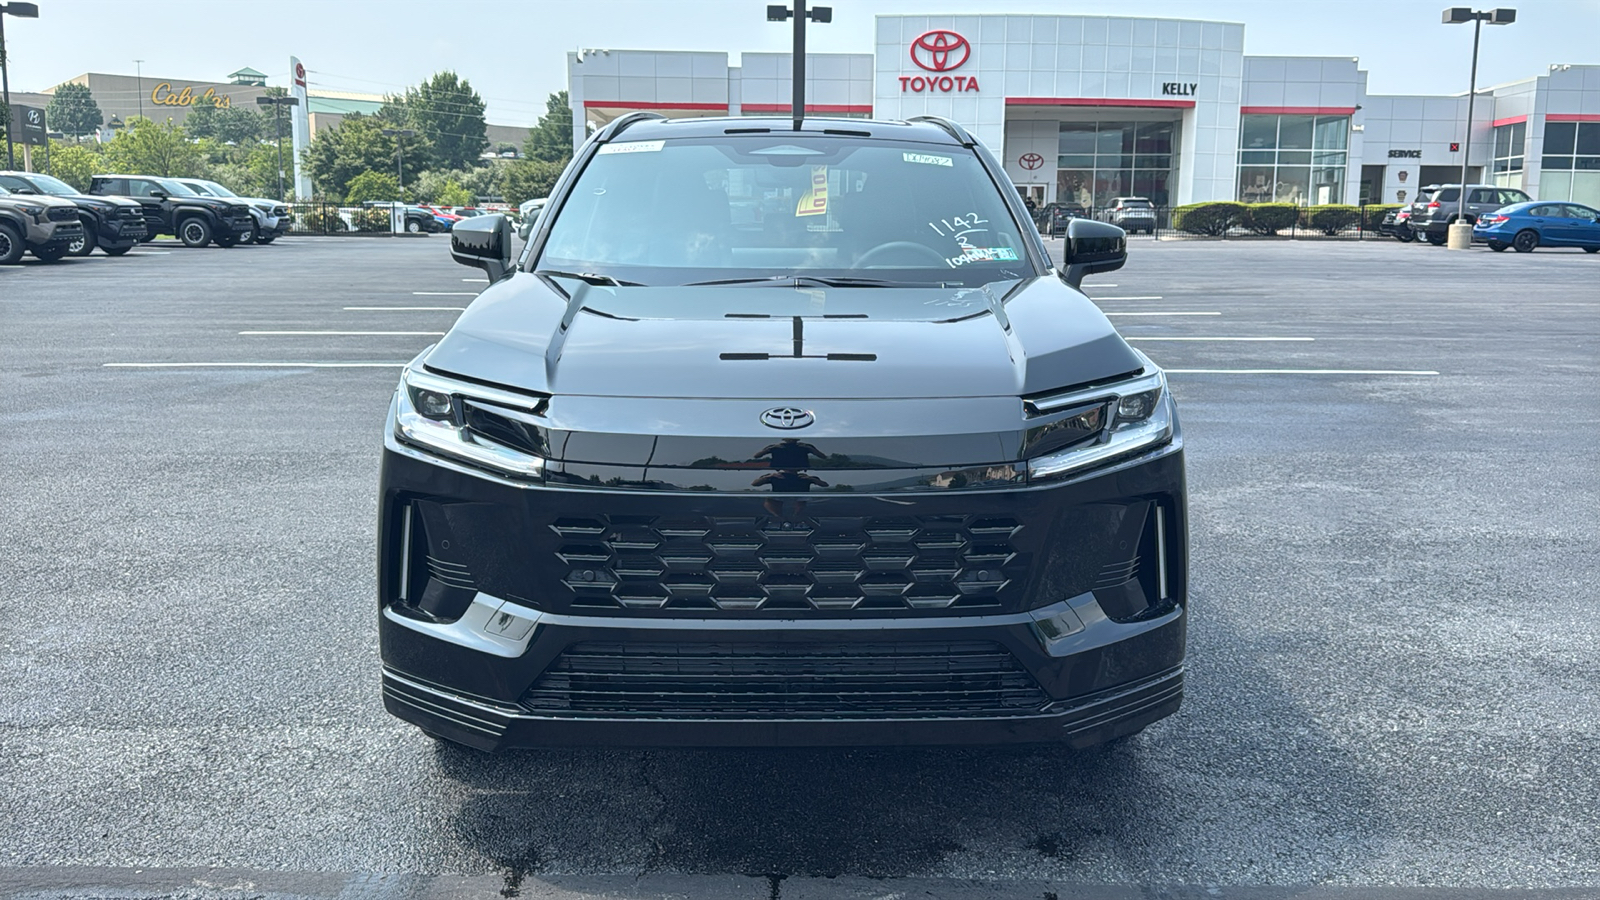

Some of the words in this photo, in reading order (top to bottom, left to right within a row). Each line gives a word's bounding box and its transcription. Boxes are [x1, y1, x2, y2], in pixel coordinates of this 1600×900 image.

[898, 76, 979, 92] TOYOTA
[1162, 82, 1197, 96] KELLY
[1387, 149, 1422, 158] SERVICE
[813, 165, 827, 207] SOLD
[929, 212, 989, 237] 1142
